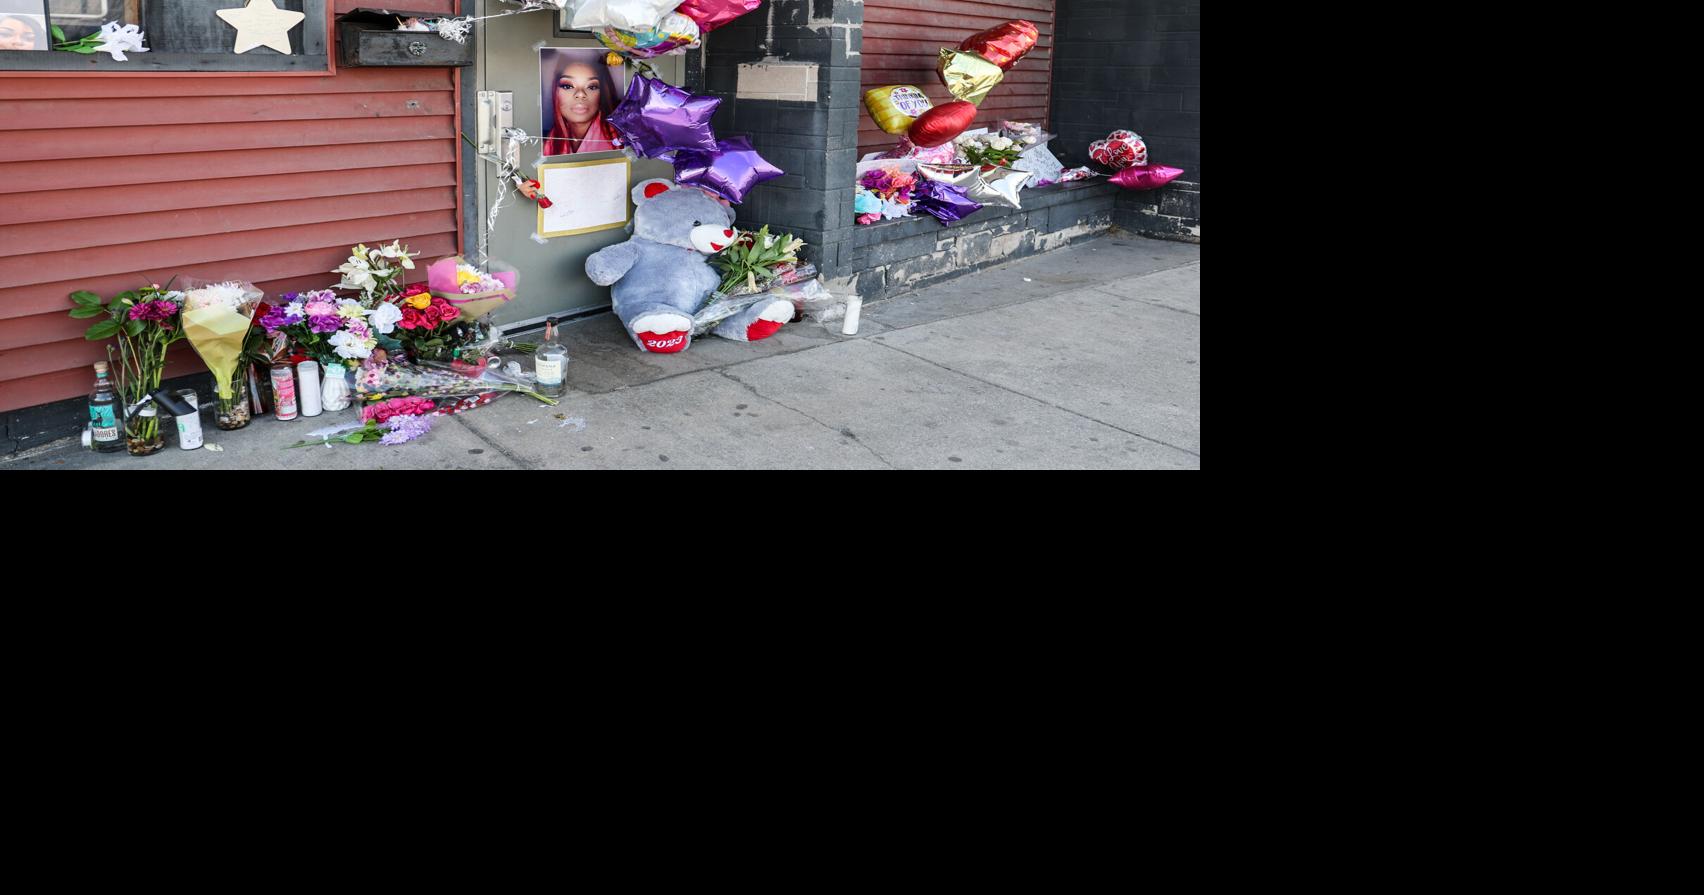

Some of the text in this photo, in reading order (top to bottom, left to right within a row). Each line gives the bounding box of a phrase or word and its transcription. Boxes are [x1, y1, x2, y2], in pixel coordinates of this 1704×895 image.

[899, 99, 929, 110] OF YOU
[1106, 143, 1129, 162] Love
[646, 335, 684, 348] 2023
